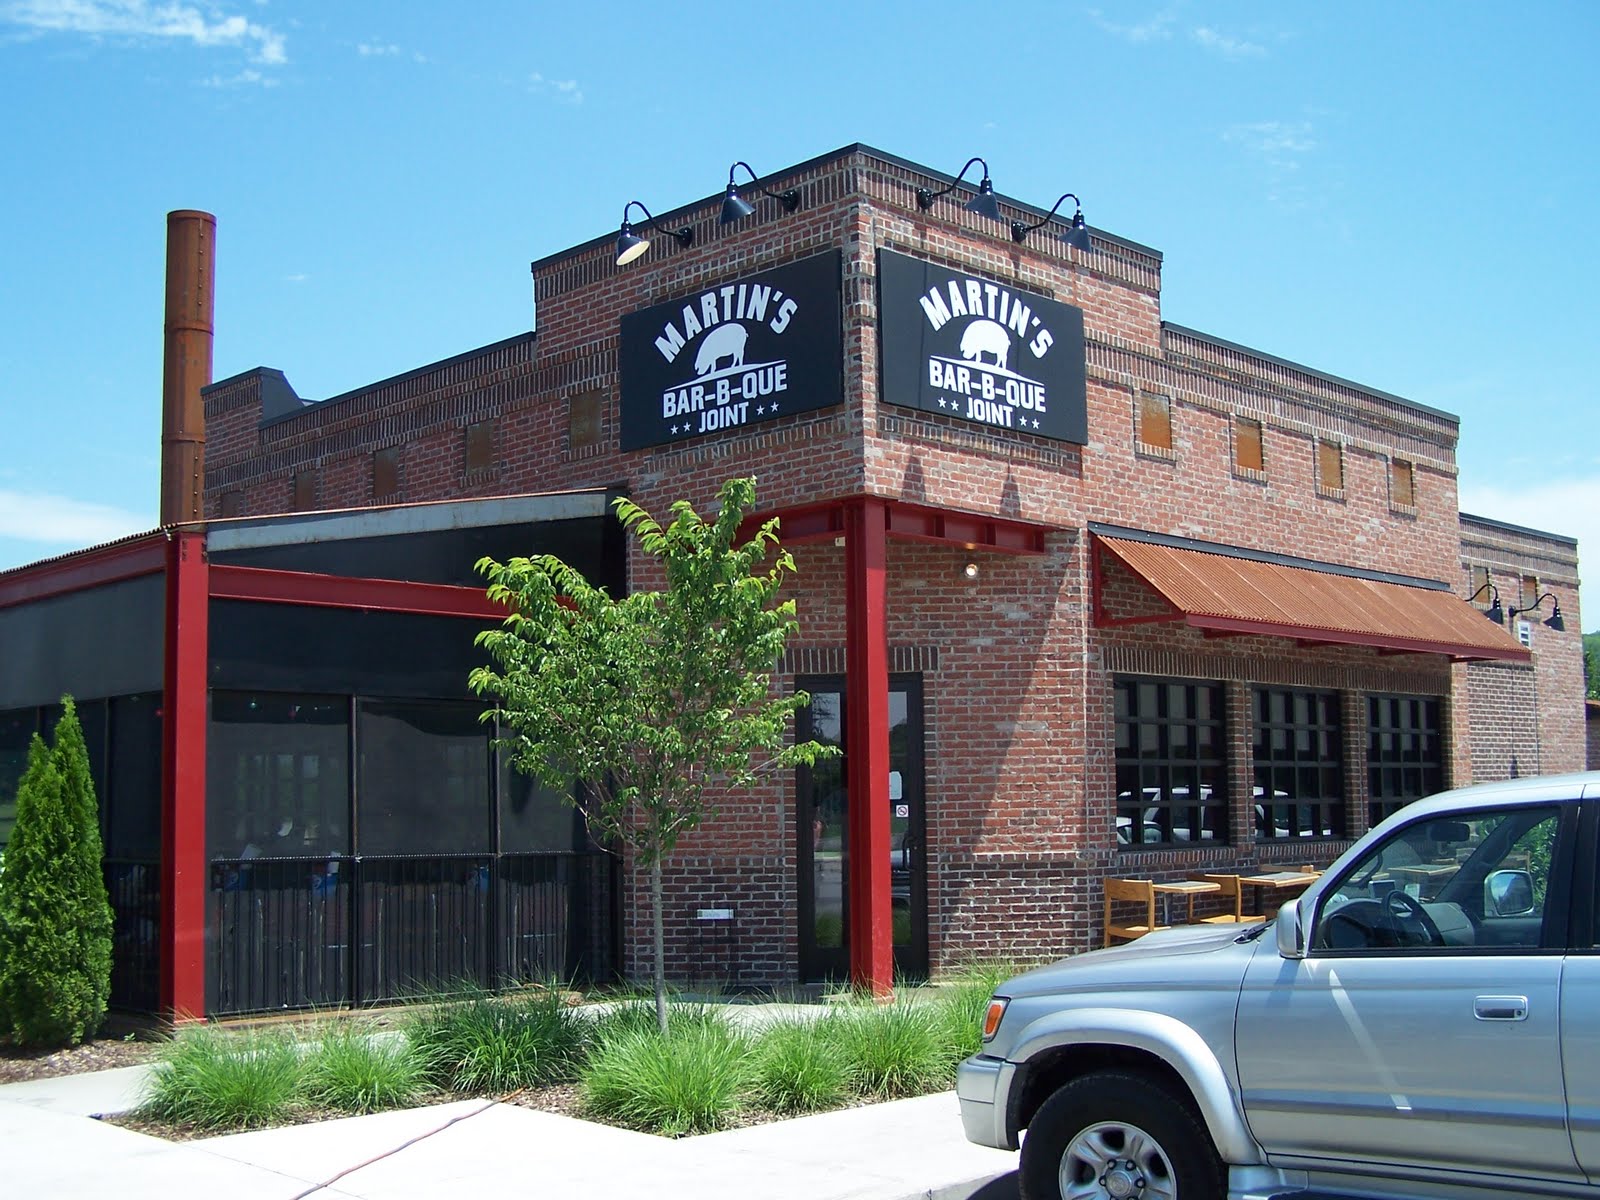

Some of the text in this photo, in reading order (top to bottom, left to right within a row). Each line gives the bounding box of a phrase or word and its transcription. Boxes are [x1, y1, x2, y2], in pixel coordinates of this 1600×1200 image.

[655, 284, 798, 364] MARTIN'S
[919, 280, 1054, 359] MARTIN'S
[663, 364, 788, 419] BAR-B-QUE
[929, 359, 1047, 413] BAR-B-QUE
[966, 397, 1014, 428] JOINT
[698, 402, 749, 433] JOINT
